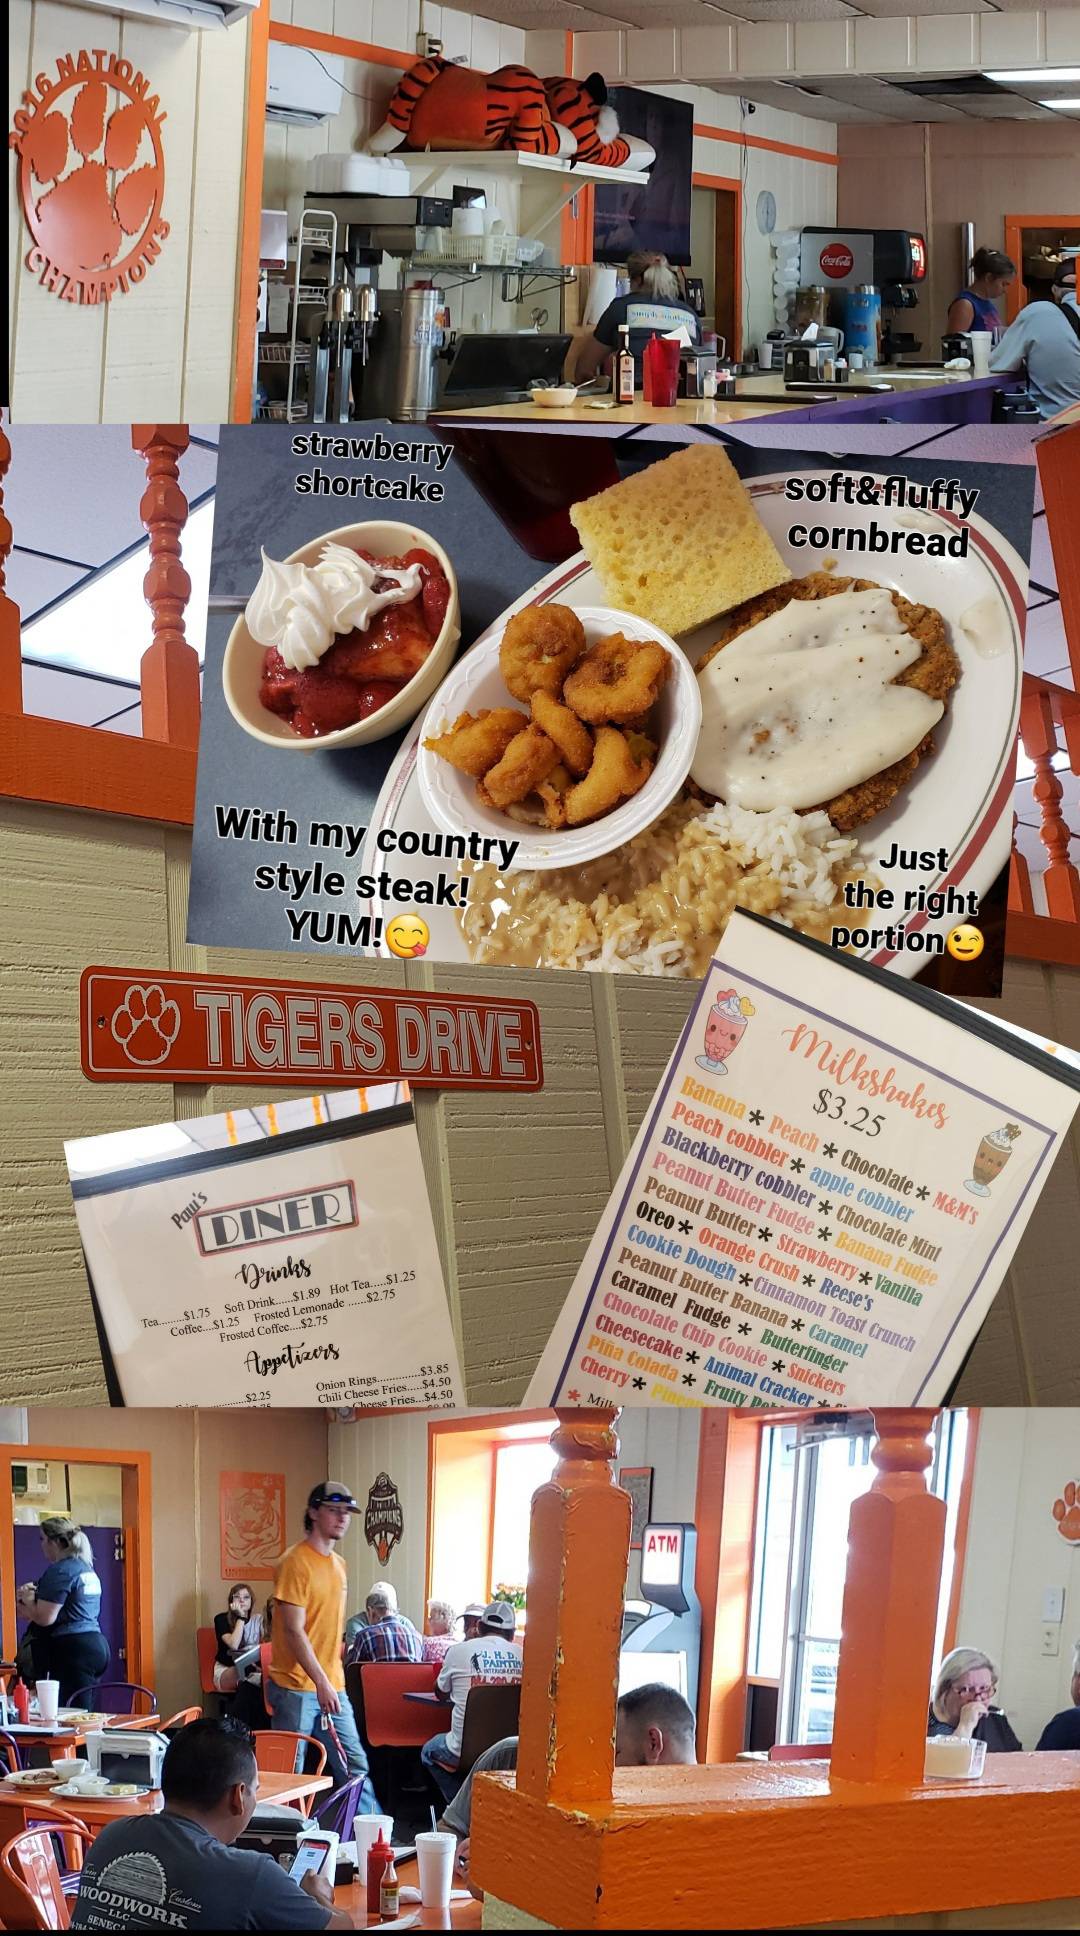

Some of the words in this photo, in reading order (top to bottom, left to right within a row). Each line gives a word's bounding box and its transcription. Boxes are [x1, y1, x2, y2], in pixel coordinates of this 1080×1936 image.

[56, 49, 168, 128] NATIONAL
[25, 218, 171, 305] CHAMPIONS
[193, 990, 385, 1074] TIGERS
[396, 1004, 526, 1077] DRIVE
[781, 1023, 951, 1129] Milkshakes
[813, 1088, 887, 1137] $3.25
[671, 1101, 724, 1139] Peach
[726, 1128, 790, 1169] cobbler
[809, 1166, 855, 1197] apple
[856, 1187, 915, 1223] cobbler
[680, 1075, 747, 1121] Banana
[768, 1114, 821, 1153] Peach
[840, 1149, 914, 1196] Chocolate
[932, 1191, 979, 1226] M&M's
[171, 1191, 208, 1230] Paul's
[211, 1193, 341, 1246] DINER
[652, 1151, 714, 1191] Peanut
[714, 1178, 767, 1215] Butter
[766, 1202, 816, 1236] Fudge
[834, 1231, 894, 1268] Banana
[893, 1257, 939, 1287] Fudge
[661, 1125, 754, 1182] Blackberry
[755, 1170, 817, 1209] cobbler
[836, 1204, 908, 1248] Chocolate
[908, 1235, 943, 1262] Mint
[636, 1200, 675, 1230] Oreo
[698, 1227, 756, 1264] Orange
[758, 1252, 800, 1283] Crush
[819, 1277, 874, 1312] Reese's
[643, 1175, 705, 1216] Peanut
[705, 1202, 757, 1238] Butter
[776, 1233, 860, 1281] Strawberry
[874, 1273, 924, 1307] Vanilla
[224, 1301, 245, 1314] Soft
[330, 1283, 349, 1295] Hot
[235, 1255, 312, 1290] Drinks
[627, 1224, 683, 1259] Cookie
[684, 1247, 737, 1282] Dough
[753, 1275, 827, 1318] Cinnamon
[828, 1305, 868, 1334] Toast
[868, 1322, 917, 1353] Crunch
[253, 1307, 290, 1323] Frosted
[292, 1298, 345, 1316] Lemonade
[611, 1270, 678, 1309] Caramel
[683, 1298, 731, 1330] Fudge
[759, 1328, 848, 1374] Butterfinger
[617, 1247, 678, 1284] Peanut
[678, 1271, 729, 1304] Butter
[729, 1292, 789, 1328] Banana
[808, 1323, 869, 1359] Caramel
[219, 1328, 256, 1343] Frosted
[244, 1341, 340, 1376] Appetizers
[595, 1313, 684, 1360] Cheesecake
[703, 1356, 758, 1388] Animal
[759, 1376, 815, 1408] Cracker
[602, 1292, 679, 1334] Chocolate
[682, 1322, 716, 1349] Chip
[718, 1337, 768, 1367] Cookie
[787, 1362, 846, 1397] Snickers
[315, 1380, 346, 1392] Onion
[580, 1355, 630, 1388] Cherry
[703, 1378, 749, 1407] Fruity
[627, 1350, 679, 1383] Colada
[317, 1391, 342, 1404] Chili
[344, 1387, 380, 1400] Cheese
[648, 1535, 678, 1553] ATM
[483, 1659, 522, 1668] PAINTIN
[80, 1885, 188, 1929] WOODWORK
[87, 1914, 126, 1930] SENECA
[108, 1908, 130, 1921] LLC
[168, 1888, 201, 1909] Custom
